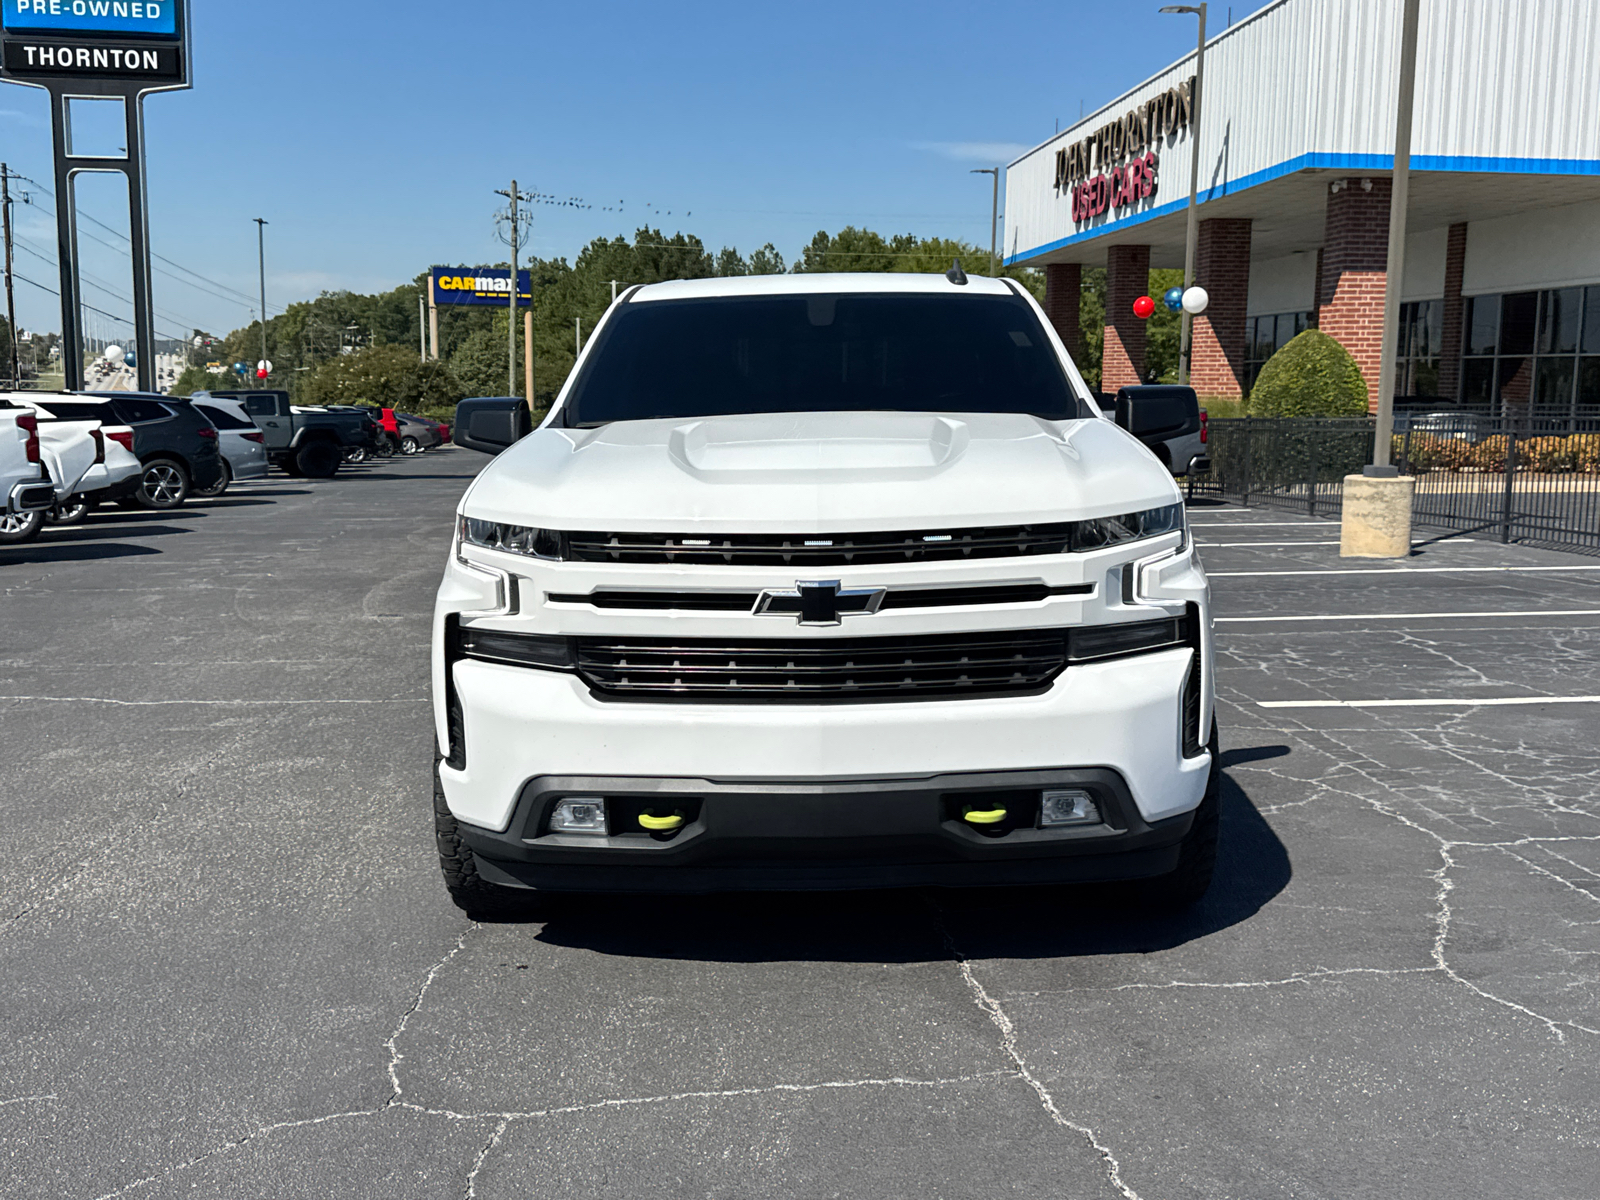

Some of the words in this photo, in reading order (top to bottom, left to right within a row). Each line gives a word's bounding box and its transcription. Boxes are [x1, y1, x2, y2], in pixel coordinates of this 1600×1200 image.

[18, 0, 160, 19] PRE-OWNED
[23, 46, 159, 69] THORNTON
[1053, 137, 1093, 188] JOHN
[1093, 75, 1197, 170] THORNTON
[1072, 174, 1107, 223] USED
[1111, 151, 1155, 208] CARS
